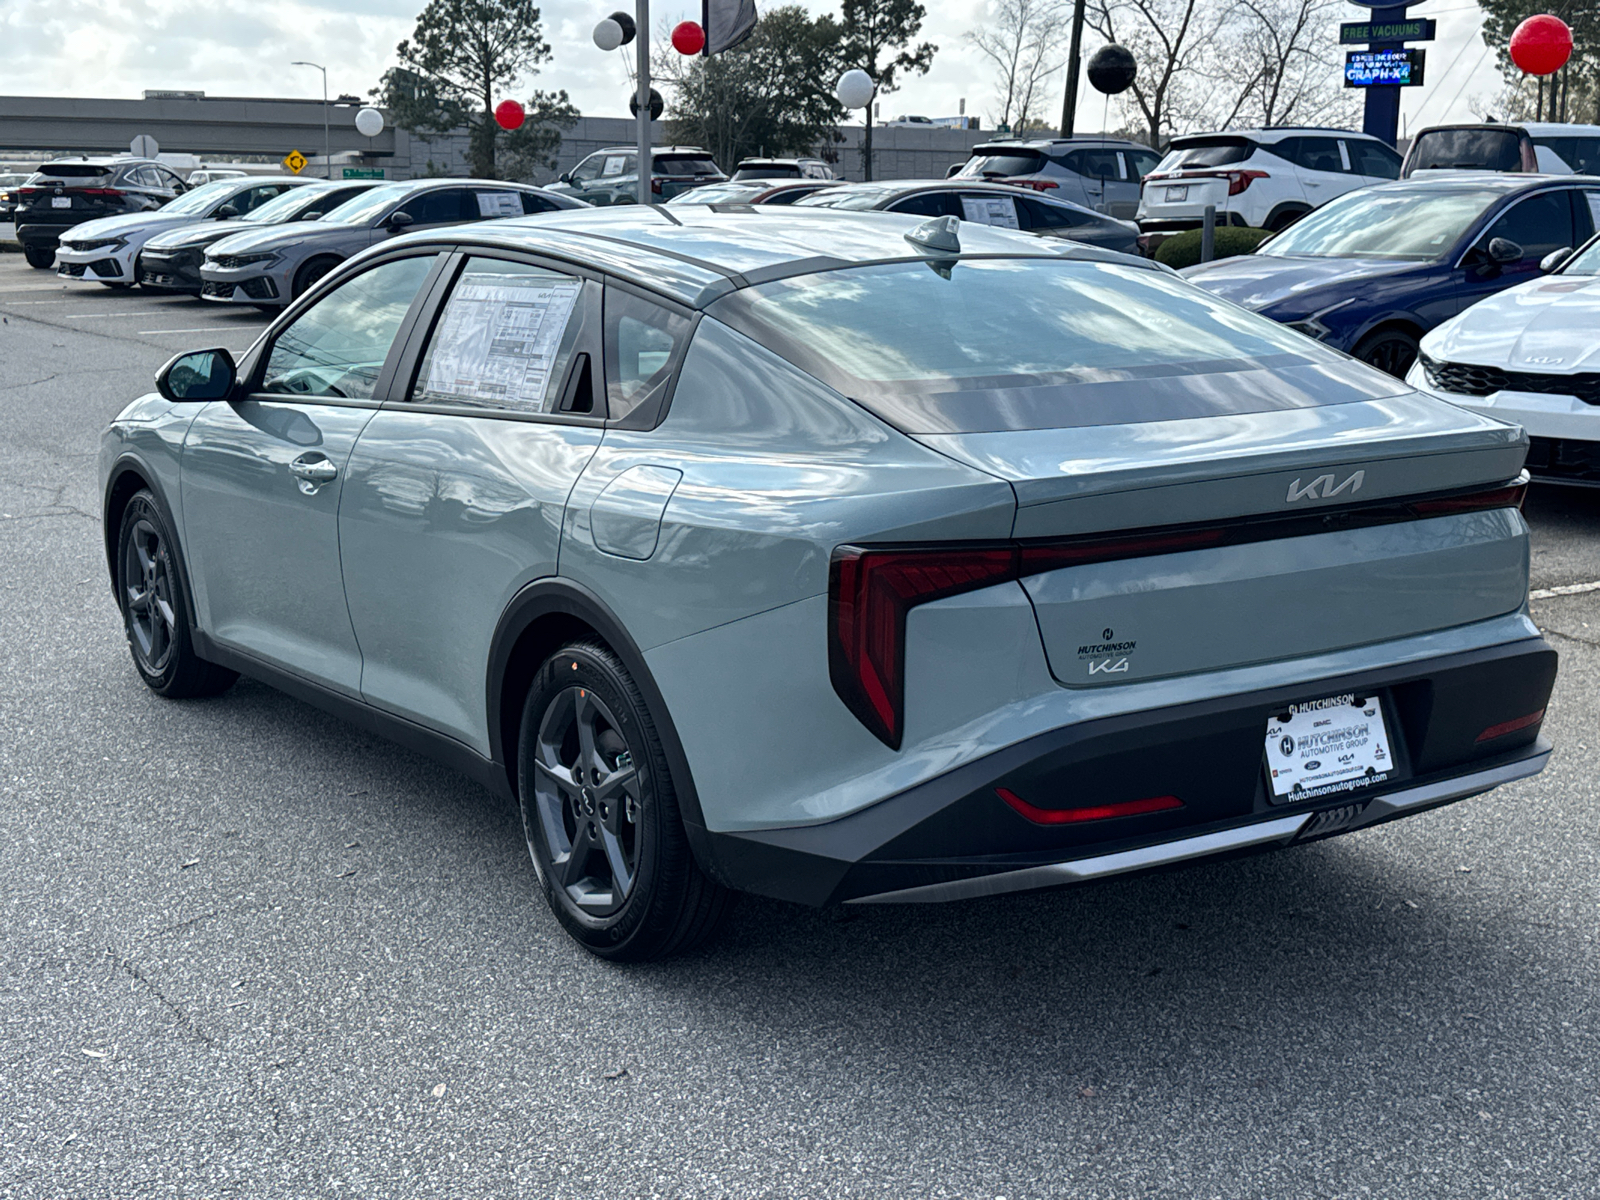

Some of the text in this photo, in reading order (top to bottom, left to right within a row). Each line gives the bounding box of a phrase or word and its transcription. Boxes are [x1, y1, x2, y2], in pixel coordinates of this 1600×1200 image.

[1343, 22, 1420, 39] FREE VACUUMS
[1346, 66, 1409, 80] GRAPH-X4
[1285, 469, 1366, 503] KIA
[1078, 641, 1137, 654] HUTCHINSON
[1089, 658, 1129, 675] K4
[1299, 693, 1355, 713] HUTCHINSON
[1298, 724, 1368, 750] HUTCHINSON
[1300, 737, 1369, 759] AUTOMOTIVE GROUP
[1287, 772, 1388, 803] Hutchinsonautogroup.com
